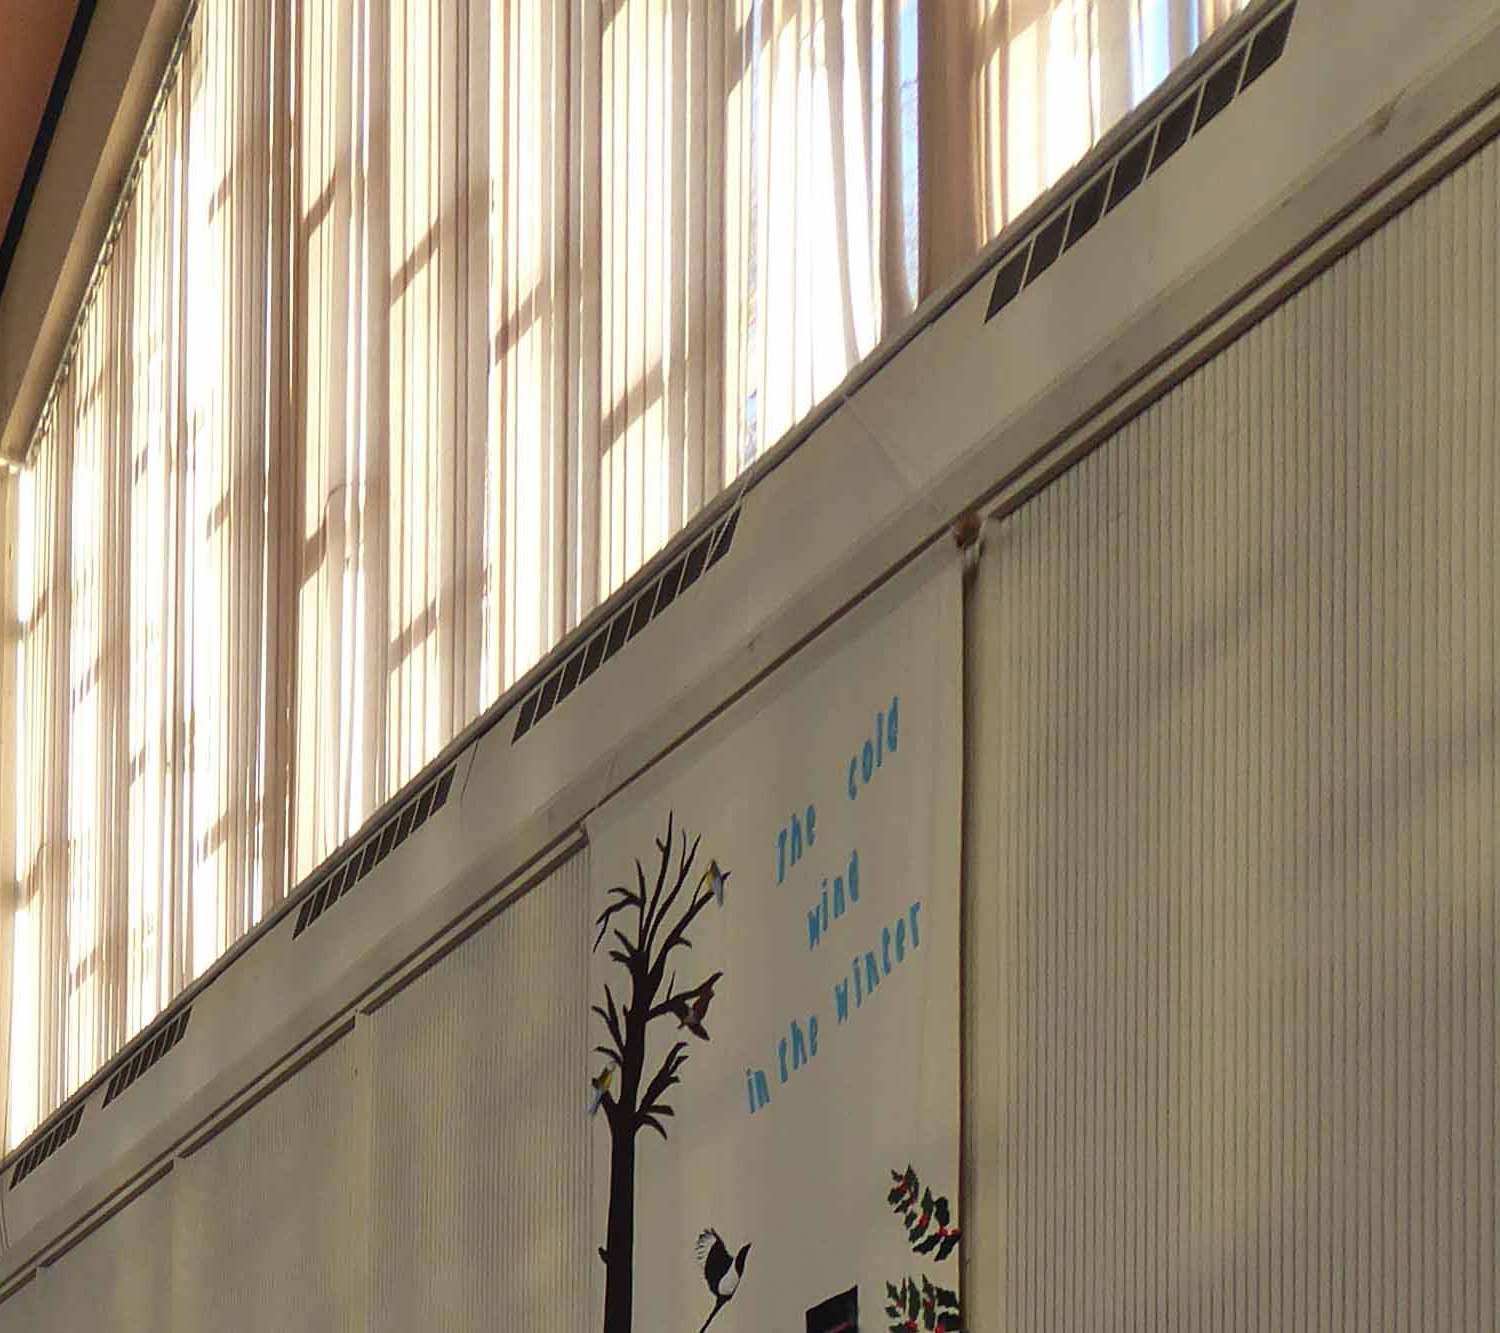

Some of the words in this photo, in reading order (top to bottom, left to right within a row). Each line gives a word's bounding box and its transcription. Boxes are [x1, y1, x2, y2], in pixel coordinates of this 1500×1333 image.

[846, 695, 900, 801] cold
[806, 849, 860, 951] wind
[745, 1067, 771, 1114] in
[775, 1015, 818, 1084] the
[833, 901, 922, 1025] winter
